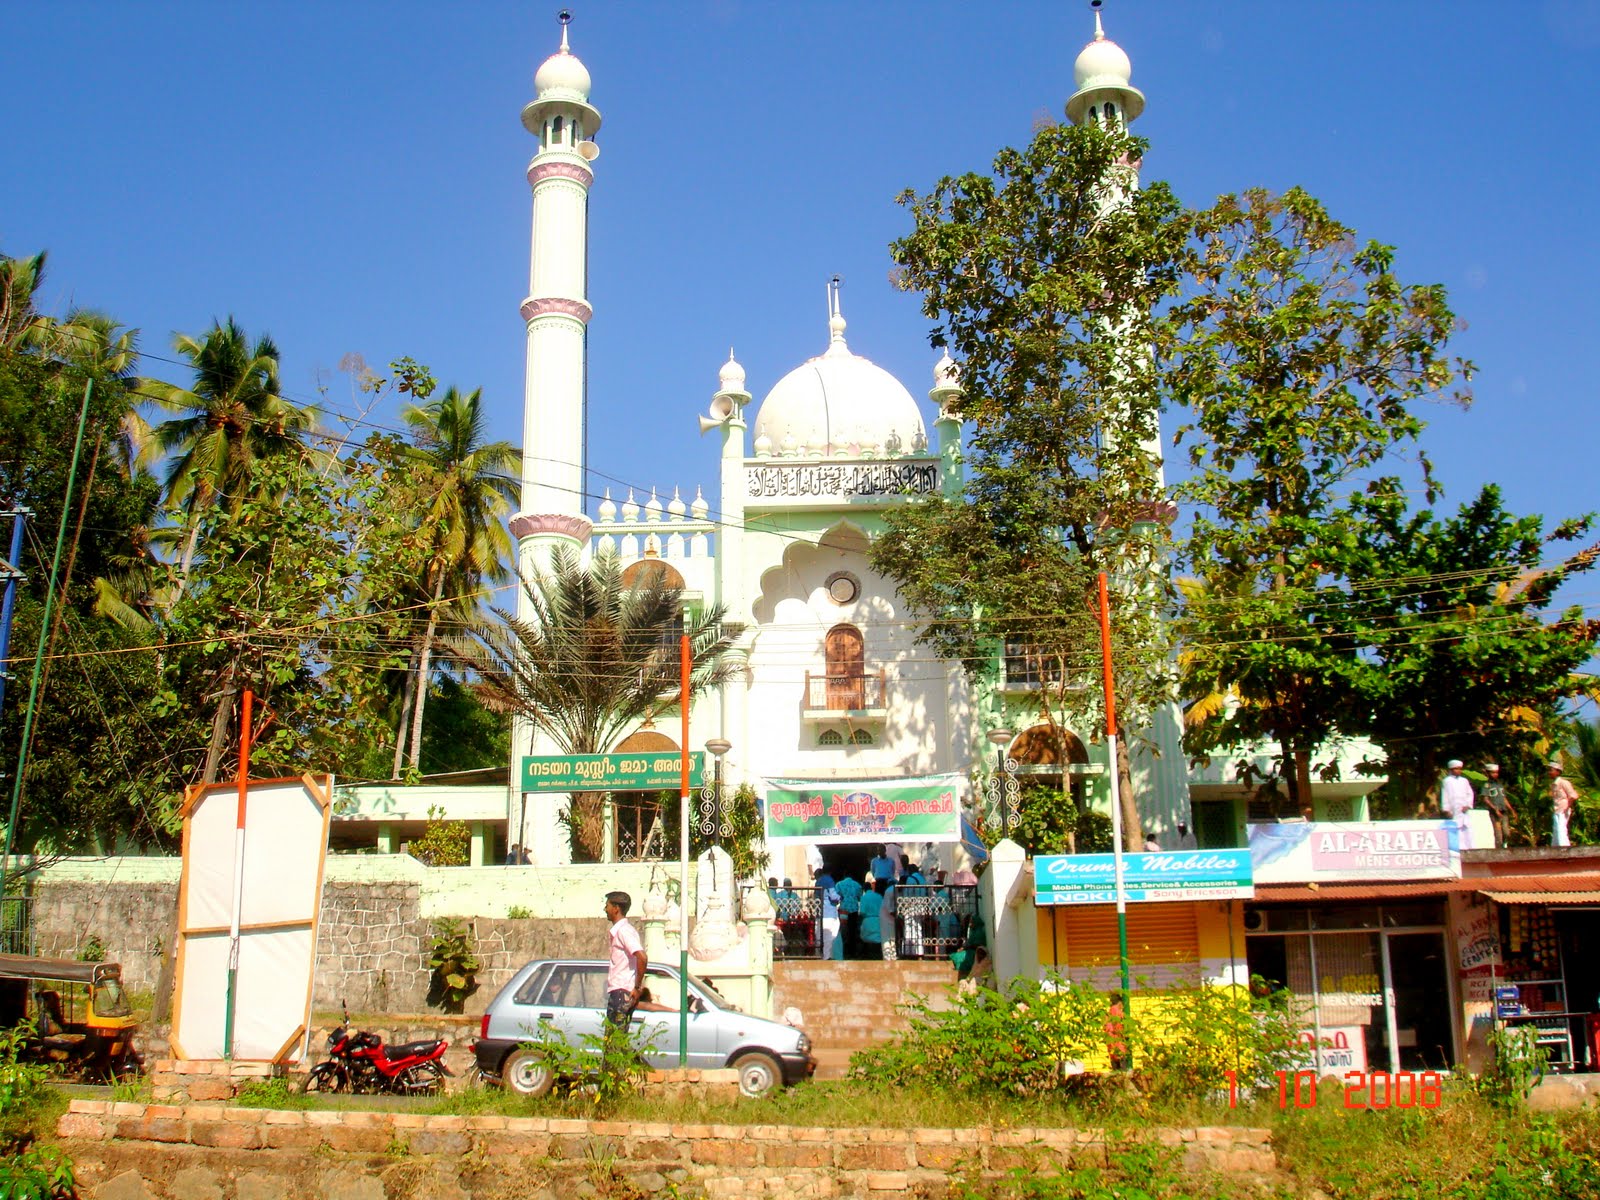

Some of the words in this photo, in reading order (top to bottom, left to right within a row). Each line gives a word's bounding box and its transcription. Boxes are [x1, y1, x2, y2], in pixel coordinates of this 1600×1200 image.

[529, 760, 571, 776] നടയറ
[1319, 831, 1442, 853] AL-ARAFA
[1141, 855, 1239, 872] Mobiles
[1355, 854, 1391, 866] MENS
[1395, 853, 1442, 866] CHOICE
[1183, 880, 1238, 888] Accessories
[1153, 889, 1183, 898] Sony
[1186, 888, 1237, 897] Ericsson
